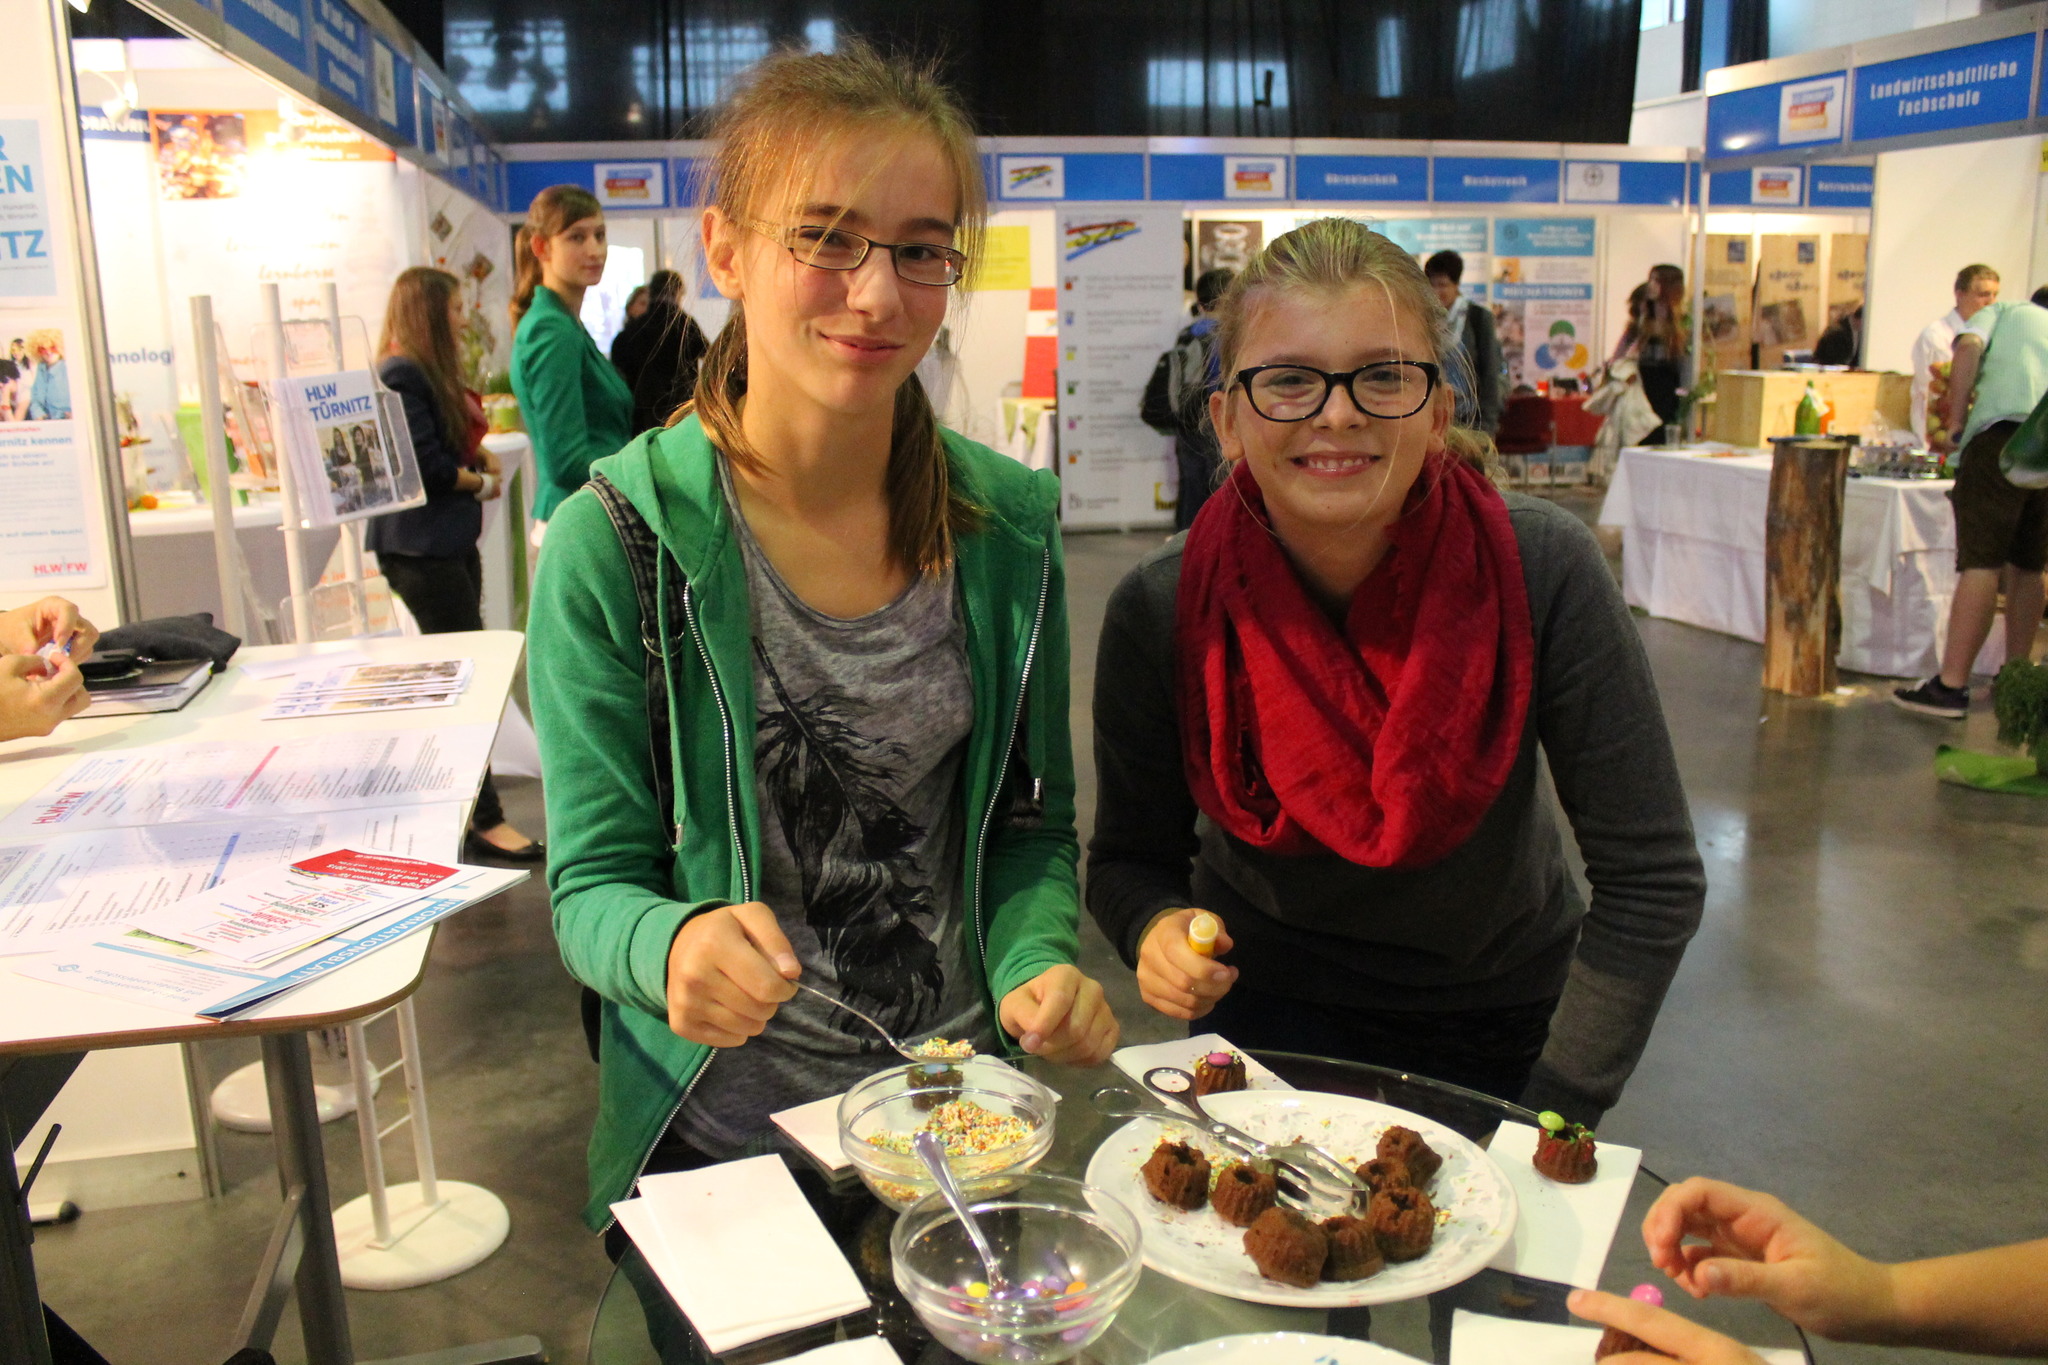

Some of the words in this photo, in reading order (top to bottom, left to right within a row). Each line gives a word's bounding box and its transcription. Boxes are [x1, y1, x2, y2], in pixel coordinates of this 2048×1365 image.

[1870, 61, 2018, 101] Landwirtschaftliche
[1898, 89, 1981, 117] Fachschule
[305, 382, 337, 402] HLW
[309, 396, 372, 421] TÜRNITZ
[33, 563, 63, 575] HLW
[66, 562, 88, 573] FW
[289, 898, 458, 981] INFORMATIONSBLATT
